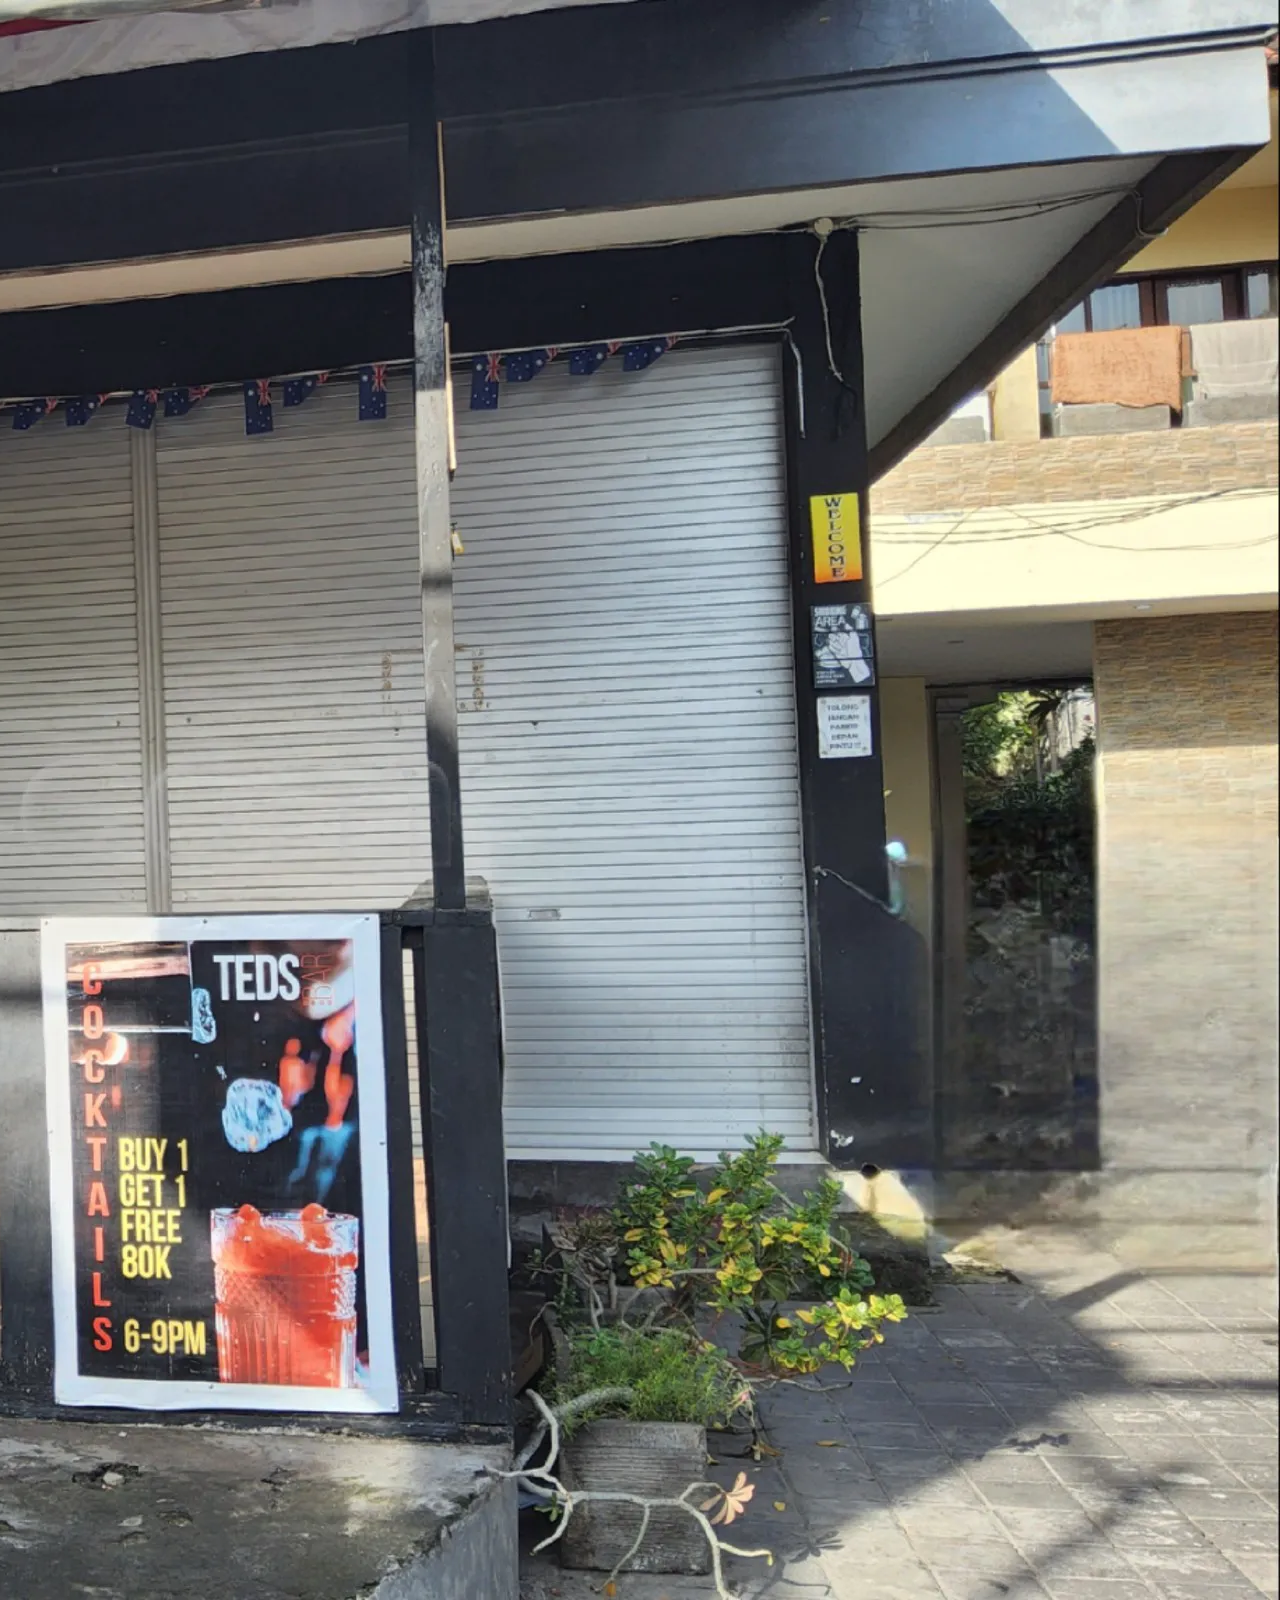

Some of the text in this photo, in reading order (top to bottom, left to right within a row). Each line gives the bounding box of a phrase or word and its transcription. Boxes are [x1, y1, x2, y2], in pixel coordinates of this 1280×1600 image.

[824, 496, 845, 578] WELCOME
[213, 953, 300, 1002] TEDS
[81, 960, 113, 1352] COCKTAILS
[119, 1137, 189, 1172] BUY 1
[120, 1173, 187, 1208] GET 1
[121, 1208, 183, 1244] FREE
[122, 1244, 173, 1280] 80K
[124, 1318, 207, 1356] 6-9PM
